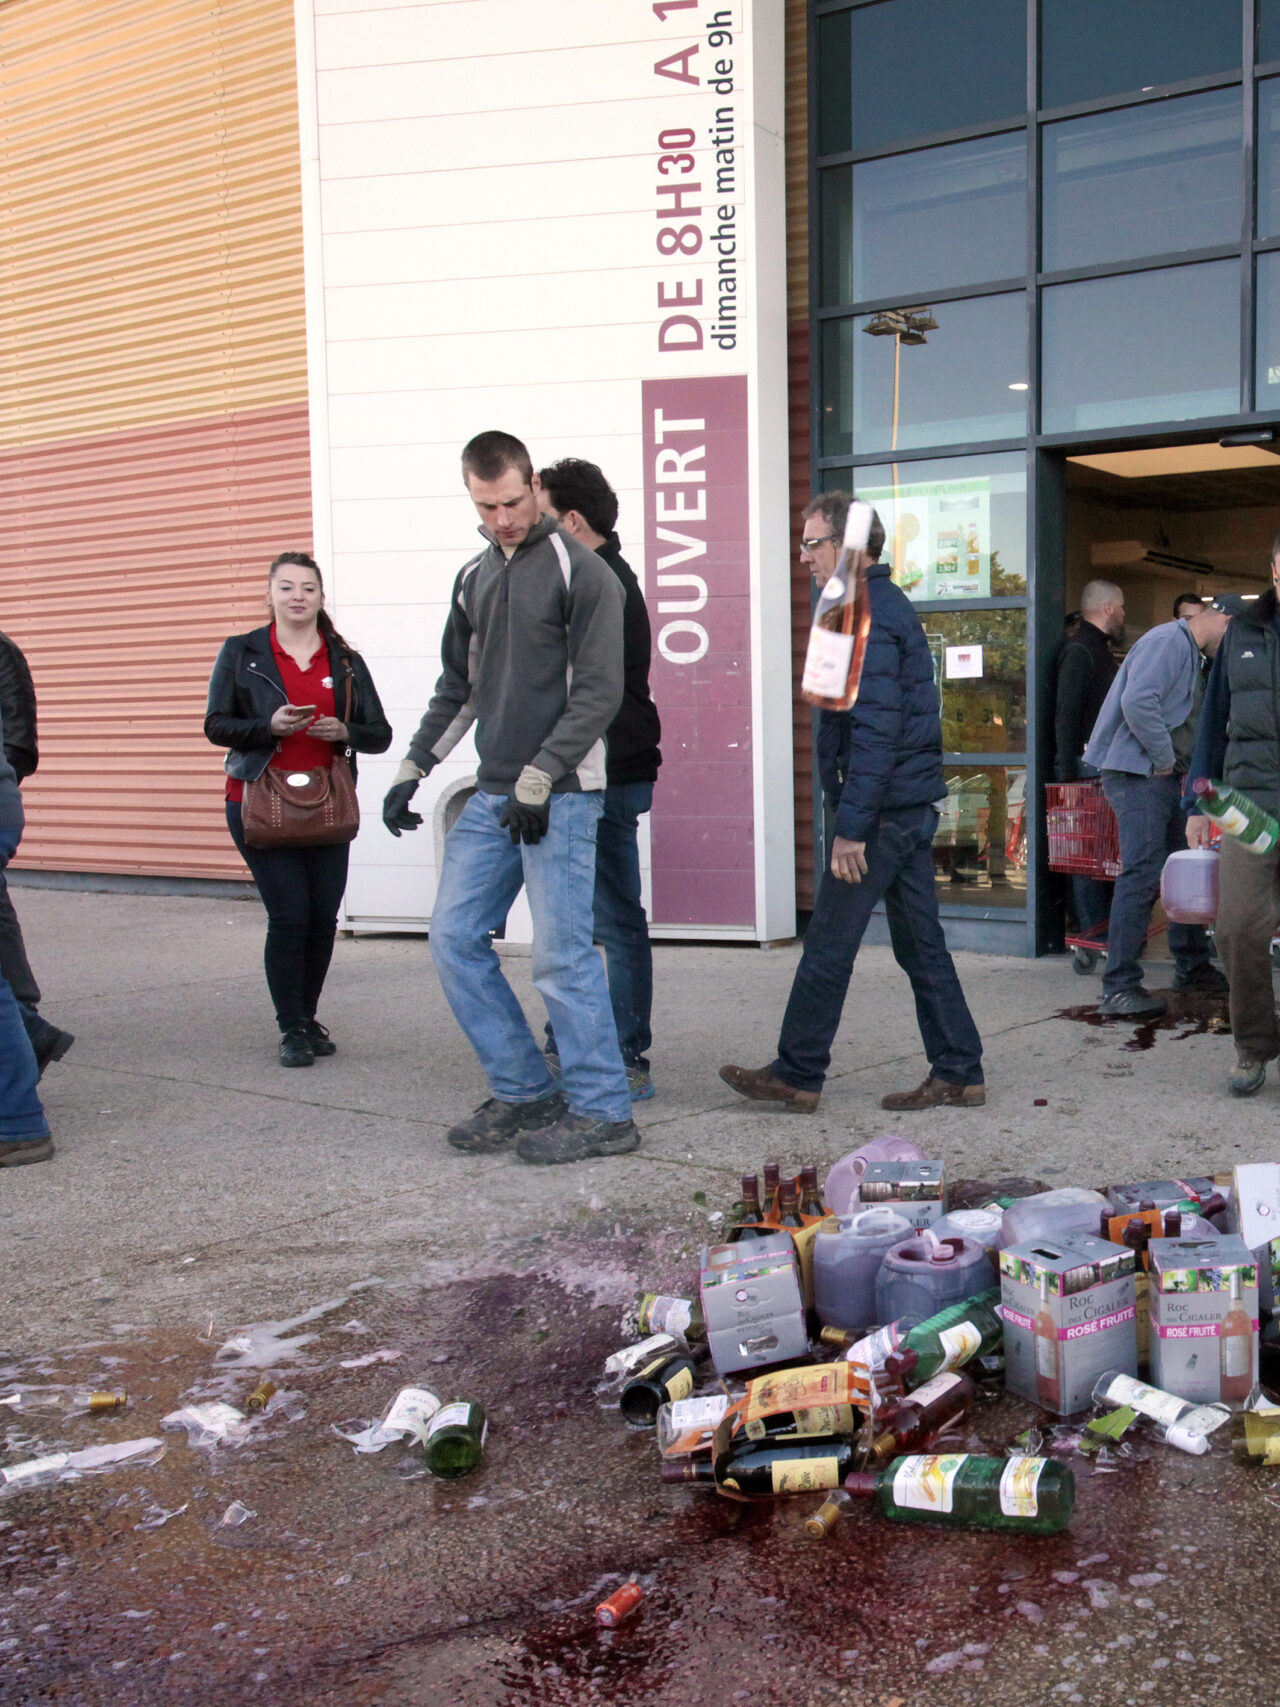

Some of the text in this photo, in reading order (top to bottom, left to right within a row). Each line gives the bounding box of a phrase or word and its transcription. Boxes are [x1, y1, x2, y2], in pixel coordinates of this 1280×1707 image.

[653, 43, 700, 87] A
[706, 10, 737, 350] dimanche matin de 9h
[657, 278, 704, 352] DE
[655, 408, 708, 664] OUVERT
